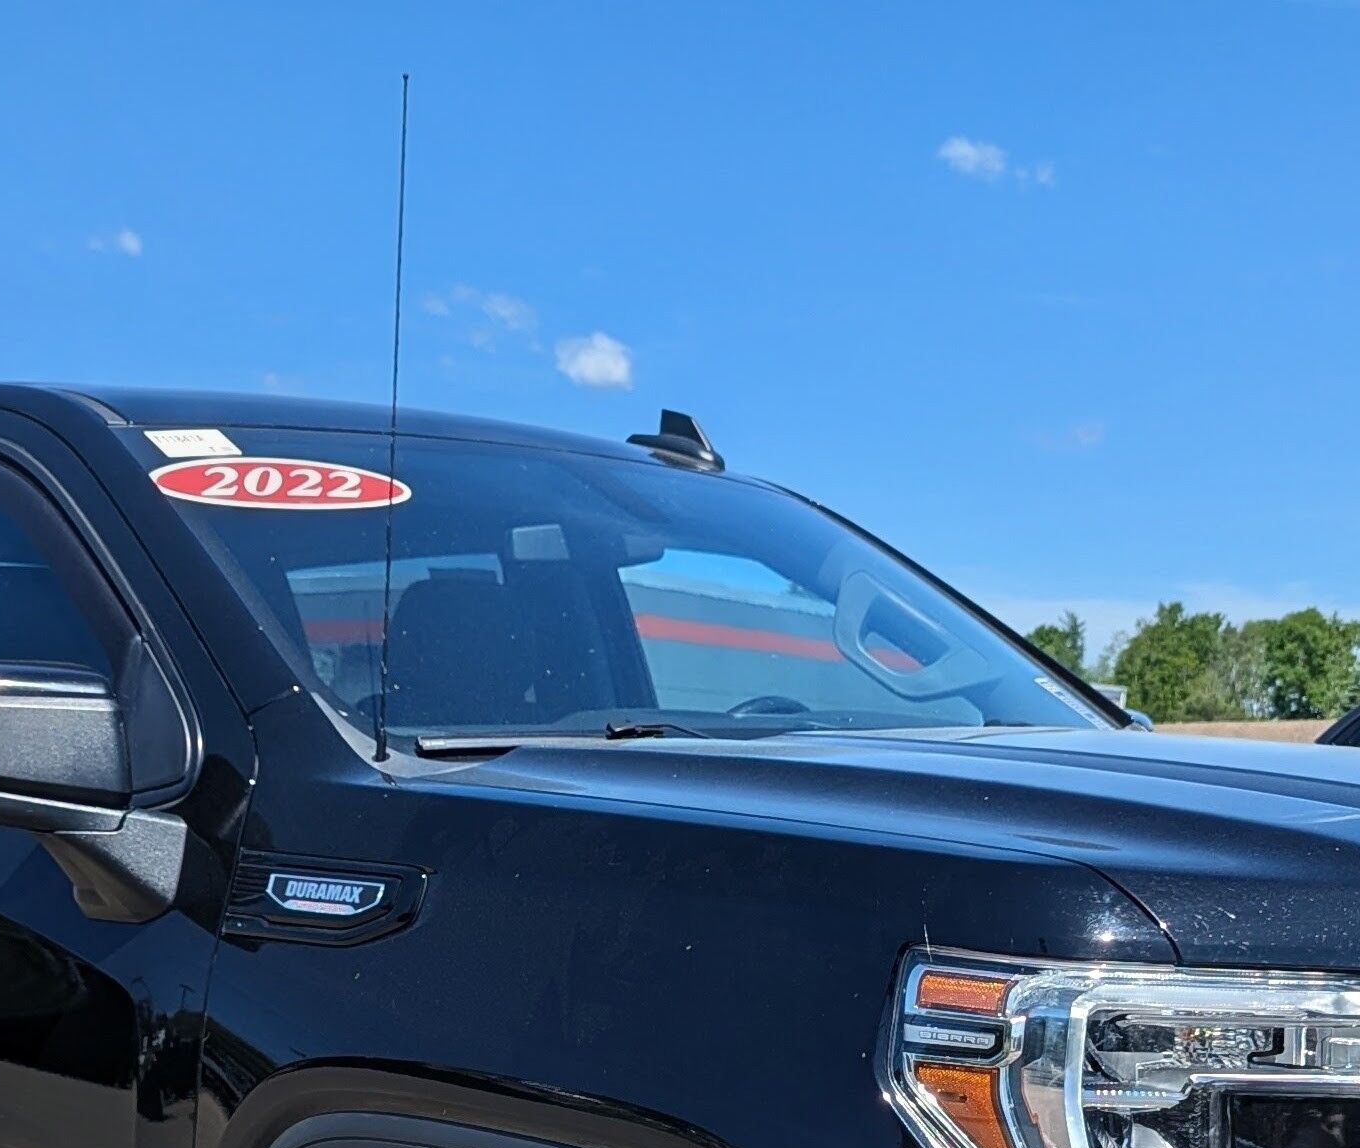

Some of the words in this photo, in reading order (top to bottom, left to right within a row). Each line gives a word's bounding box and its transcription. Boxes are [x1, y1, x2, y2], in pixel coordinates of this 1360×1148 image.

[201, 466, 362, 498] 2022
[285, 880, 364, 904] DURAMAX
[920, 1030, 989, 1045] SIERRA
